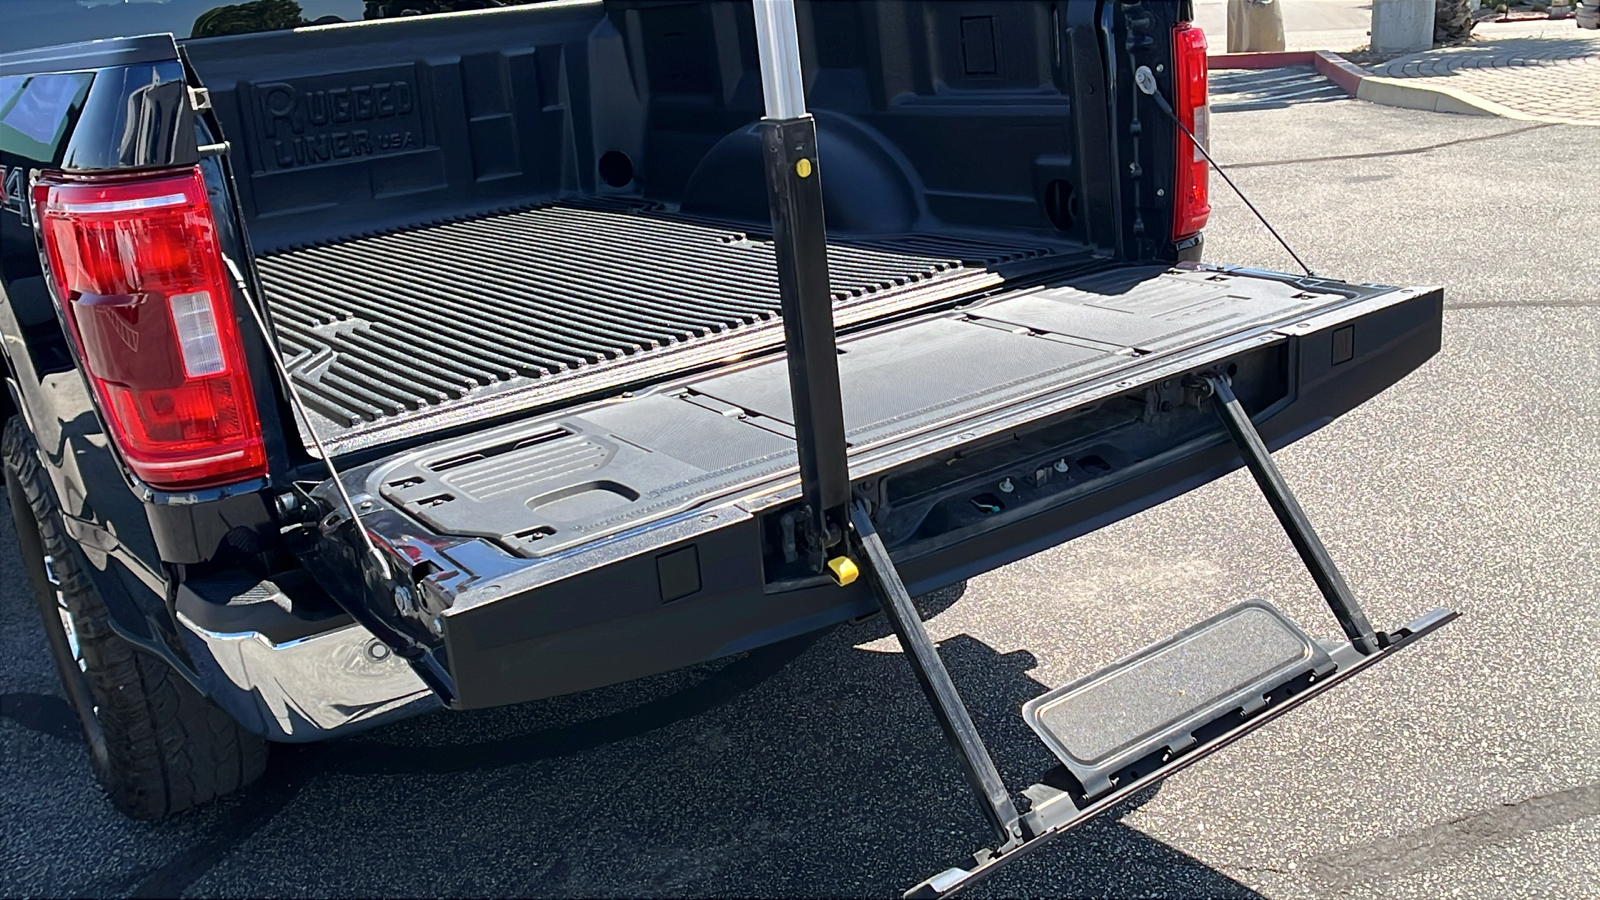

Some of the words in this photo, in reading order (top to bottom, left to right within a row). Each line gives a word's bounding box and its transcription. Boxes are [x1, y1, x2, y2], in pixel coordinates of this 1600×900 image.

[256, 81, 414, 138] RUGGED
[273, 129, 373, 168] LINER
[378, 131, 416, 150] USA
